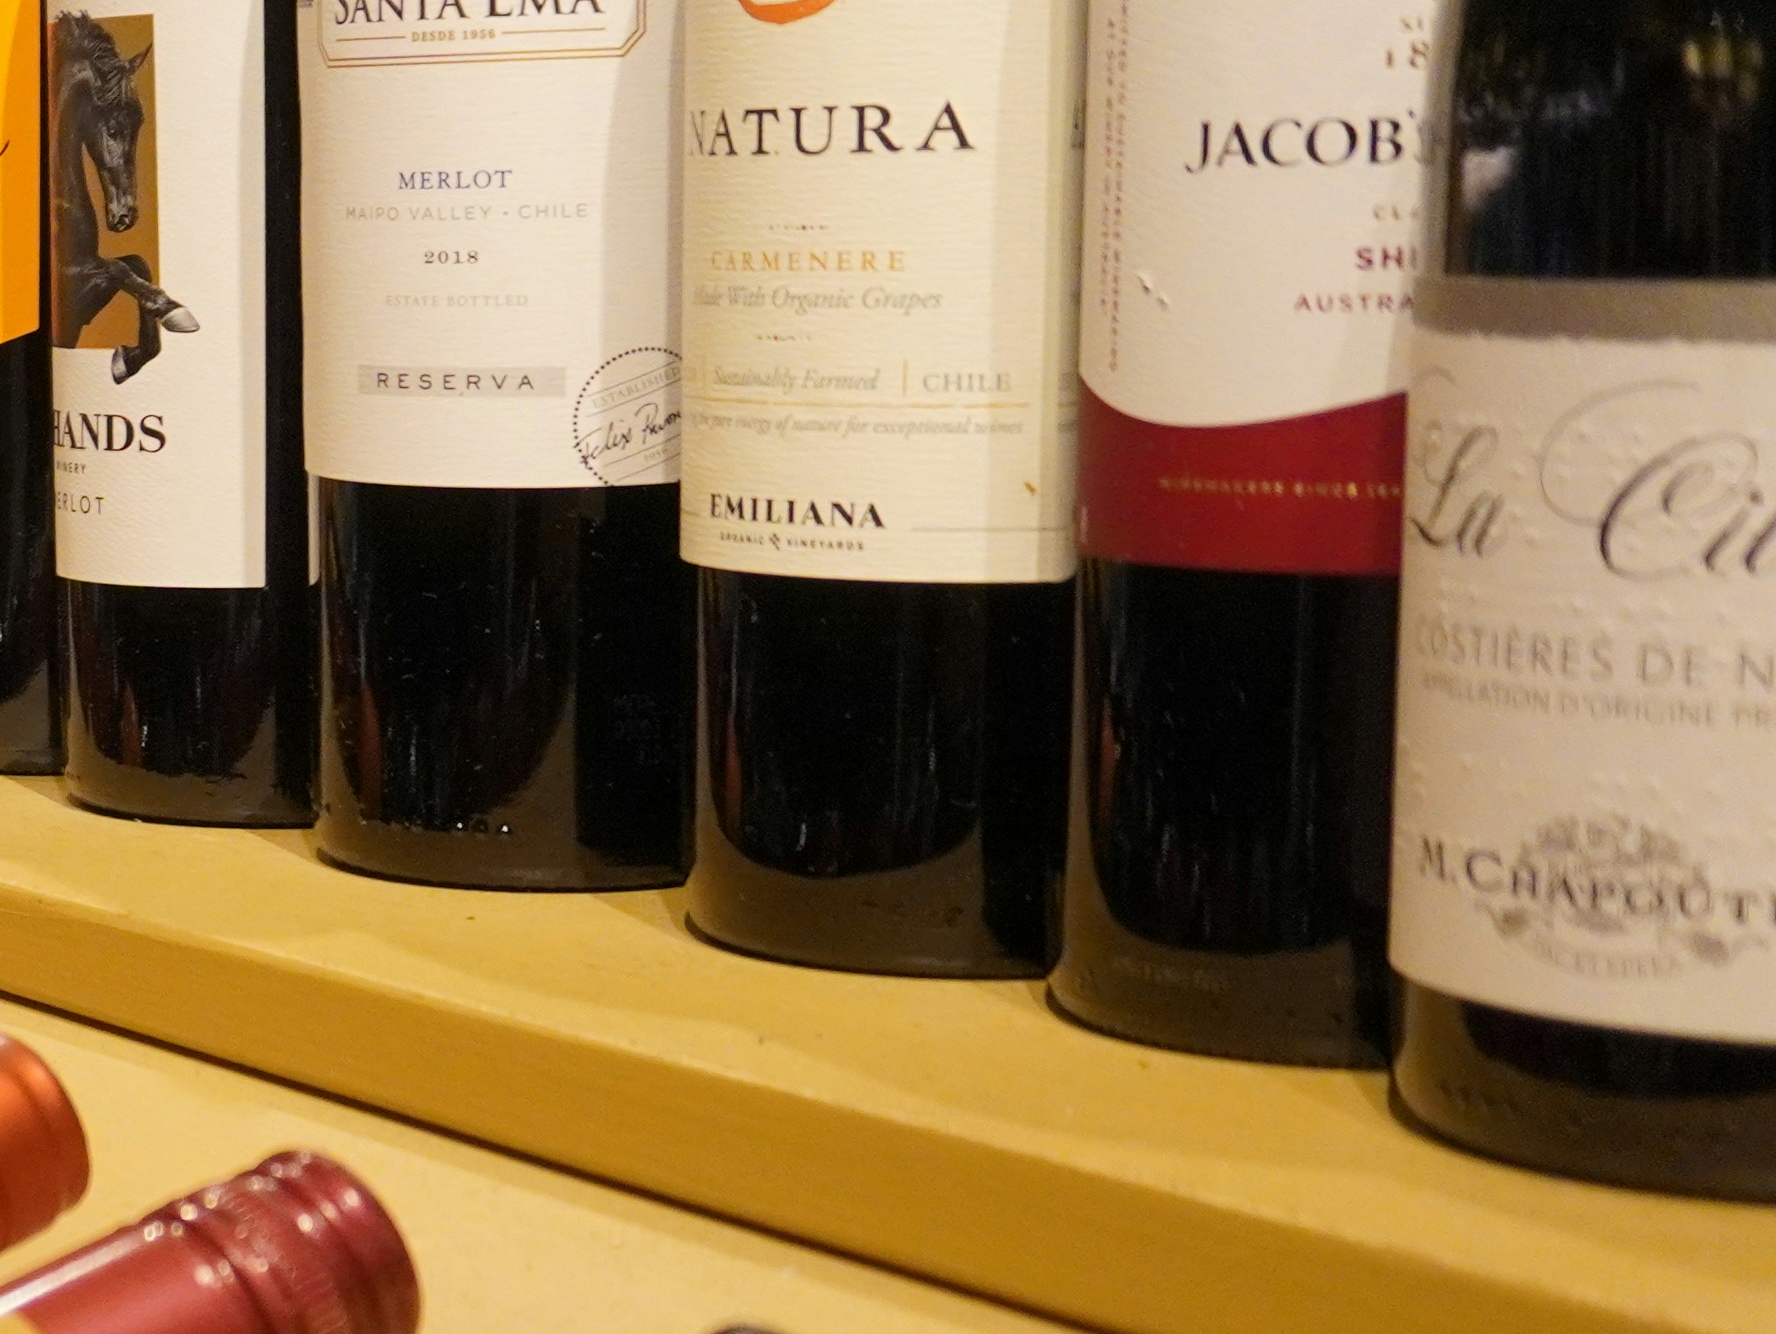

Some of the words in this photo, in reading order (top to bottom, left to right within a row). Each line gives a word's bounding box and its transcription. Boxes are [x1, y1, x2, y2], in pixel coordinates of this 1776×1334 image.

[411, 30, 455, 43] DESDE
[1184, 108, 1419, 174] JACOB'
[397, 169, 512, 190] MERLOT
[346, 206, 399, 222] MAIPO
[409, 205, 494, 222] VALLEY
[518, 202, 589, 219] CHILE
[424, 250, 479, 265] 2018
[385, 294, 439, 307] ESTATE
[447, 294, 529, 307] BOTTLED
[771, 287, 854, 315] Organic
[861, 287, 943, 316] Grapes
[1295, 293, 1415, 314] AUSTRA
[377, 373, 535, 391] RESERVA
[922, 372, 1012, 393] CHILE
[57, 491, 104, 515] ERLOT
[709, 493, 887, 529] EMILIANA
